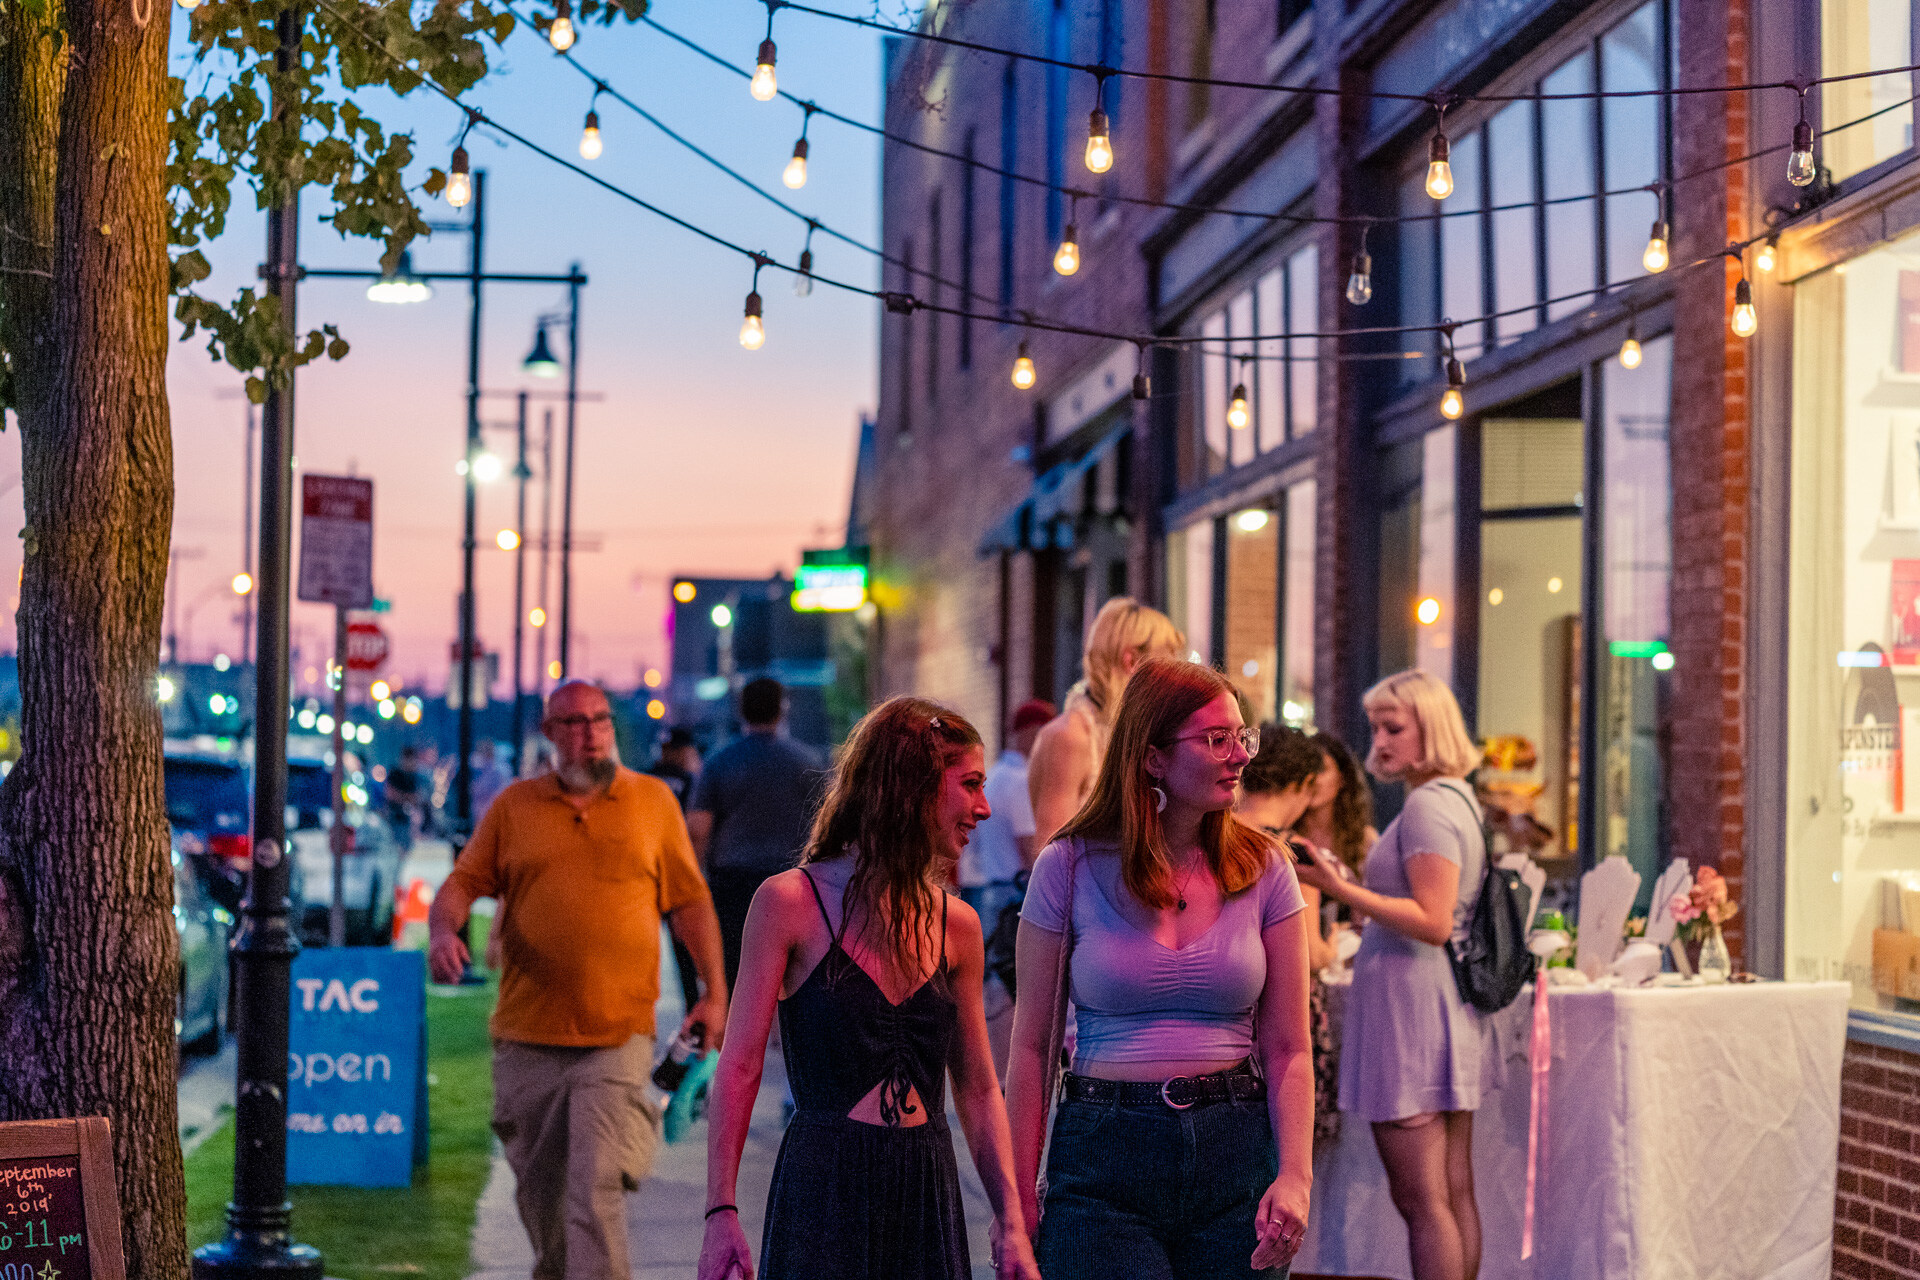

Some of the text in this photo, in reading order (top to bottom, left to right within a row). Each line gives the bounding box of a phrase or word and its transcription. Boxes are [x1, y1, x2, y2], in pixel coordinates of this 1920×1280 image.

[296, 978, 380, 1013] TAC
[0, 1163, 76, 1188] eptember
[17, 1182, 44, 1199] 6th
